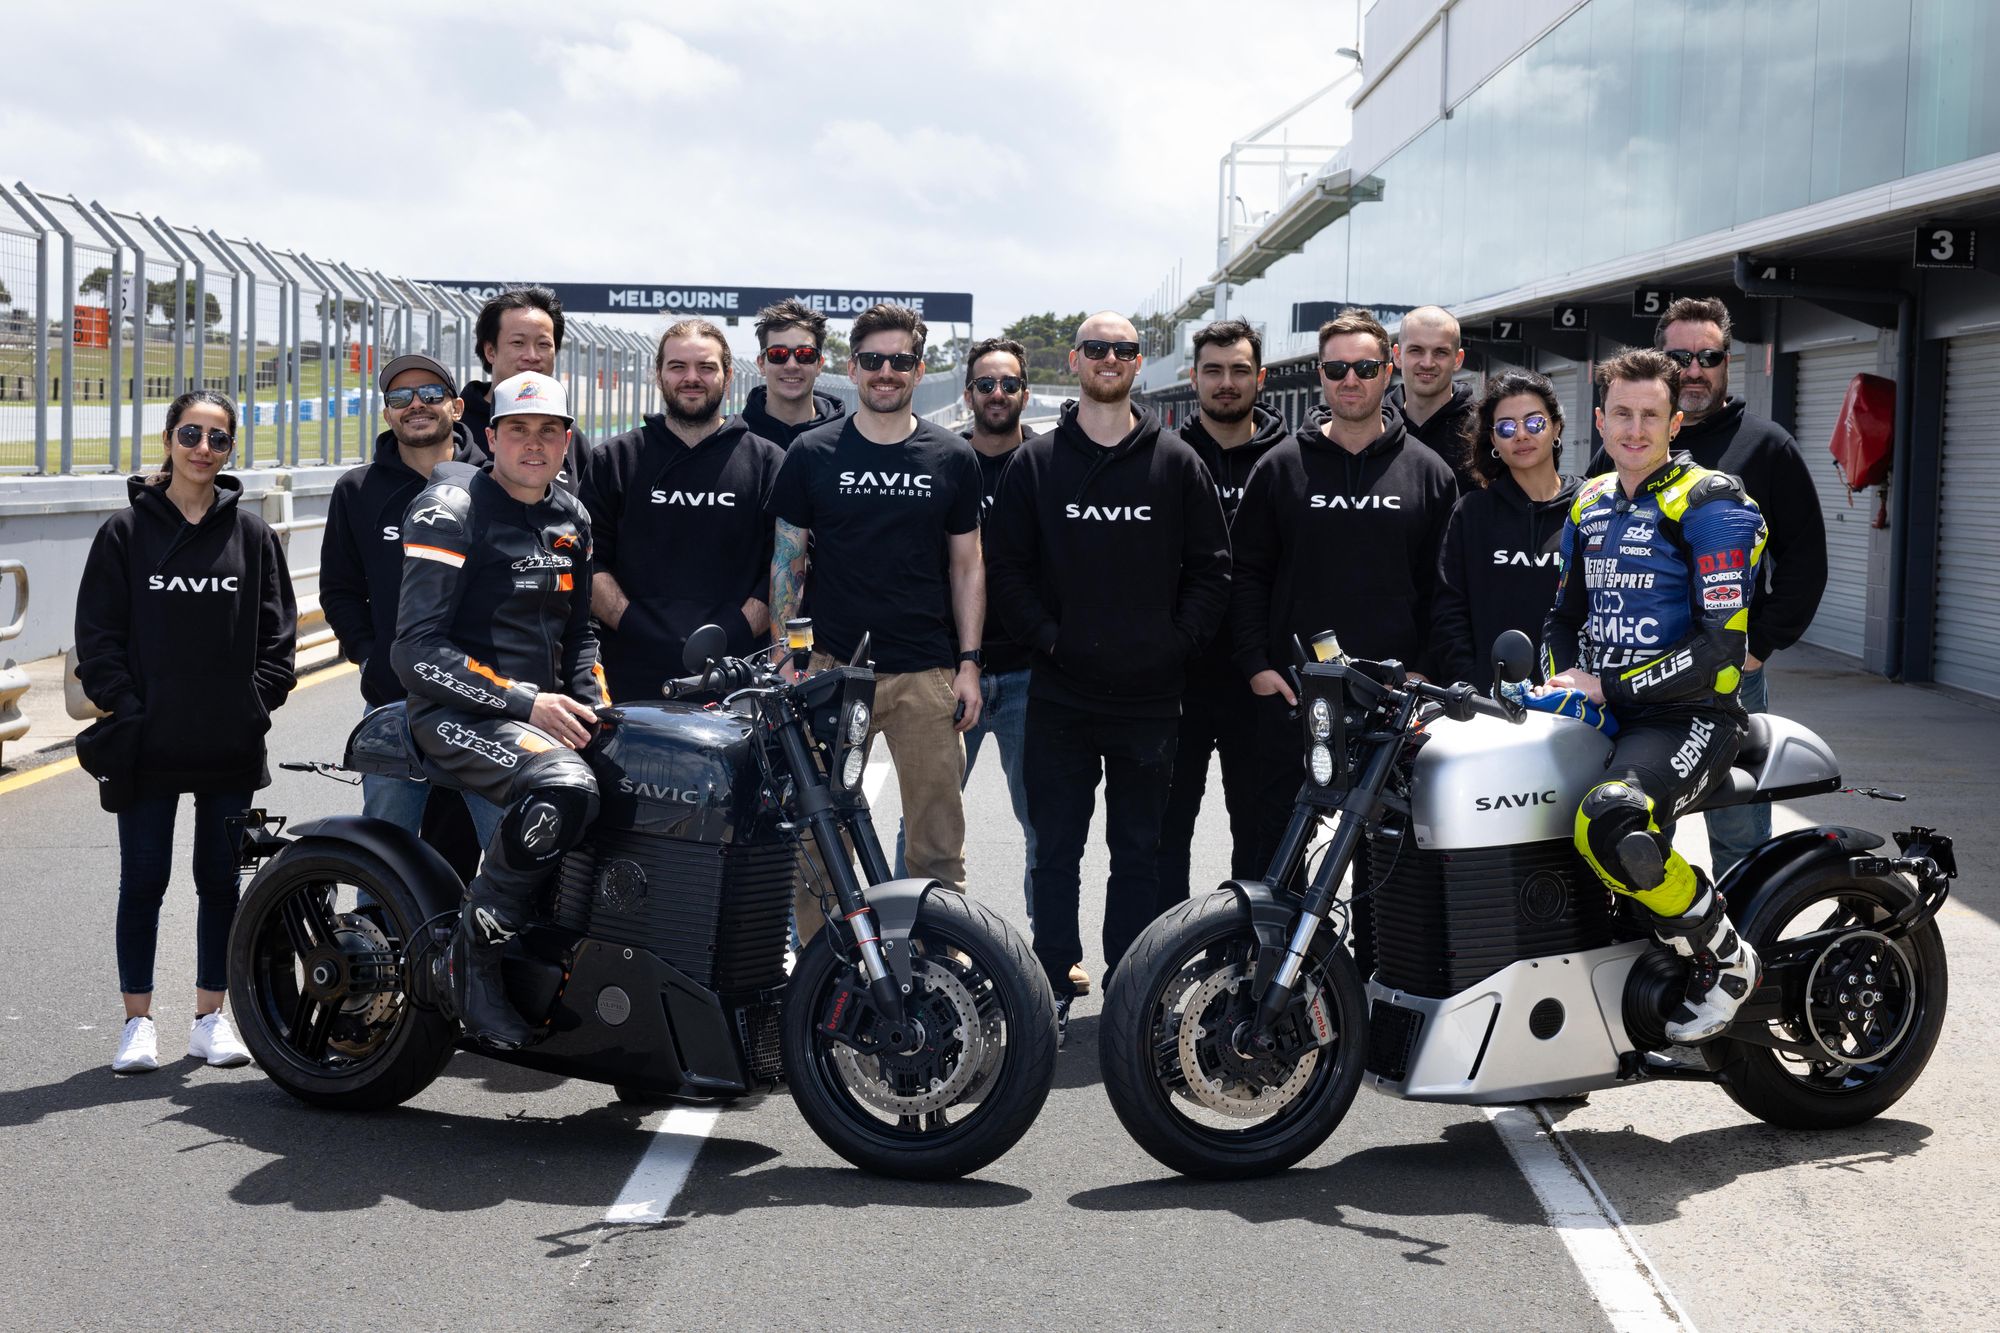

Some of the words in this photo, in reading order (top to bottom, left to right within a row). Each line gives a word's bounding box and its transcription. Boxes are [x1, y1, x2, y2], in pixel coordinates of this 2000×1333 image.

[1931, 230, 1954, 260] 3
[609, 289, 739, 309] MELBOURNE
[1644, 292, 1660, 312] 5
[1561, 308, 1576, 327] 6
[1500, 322, 1513, 338] 7
[1294, 363, 1307, 373] 14
[839, 471, 932, 489] SAVIC
[1647, 465, 1681, 491] PLUS
[651, 490, 736, 506] SAVIC
[879, 488, 931, 498] MEMBER
[1310, 494, 1401, 510] SAVIC
[1065, 503, 1151, 521] SAVIC
[1493, 549, 1560, 567] SAVI
[1619, 545, 1652, 556] VORTEX
[148, 574, 238, 593] SAVIC
[1702, 570, 1743, 585] VORTEX
[1631, 649, 1693, 694] PLUS
[1670, 716, 1716, 779] SIEMEC
[619, 777, 698, 804] SAVIC
[1475, 790, 1557, 811] SAVIC
[827, 991, 849, 1030] brembo
